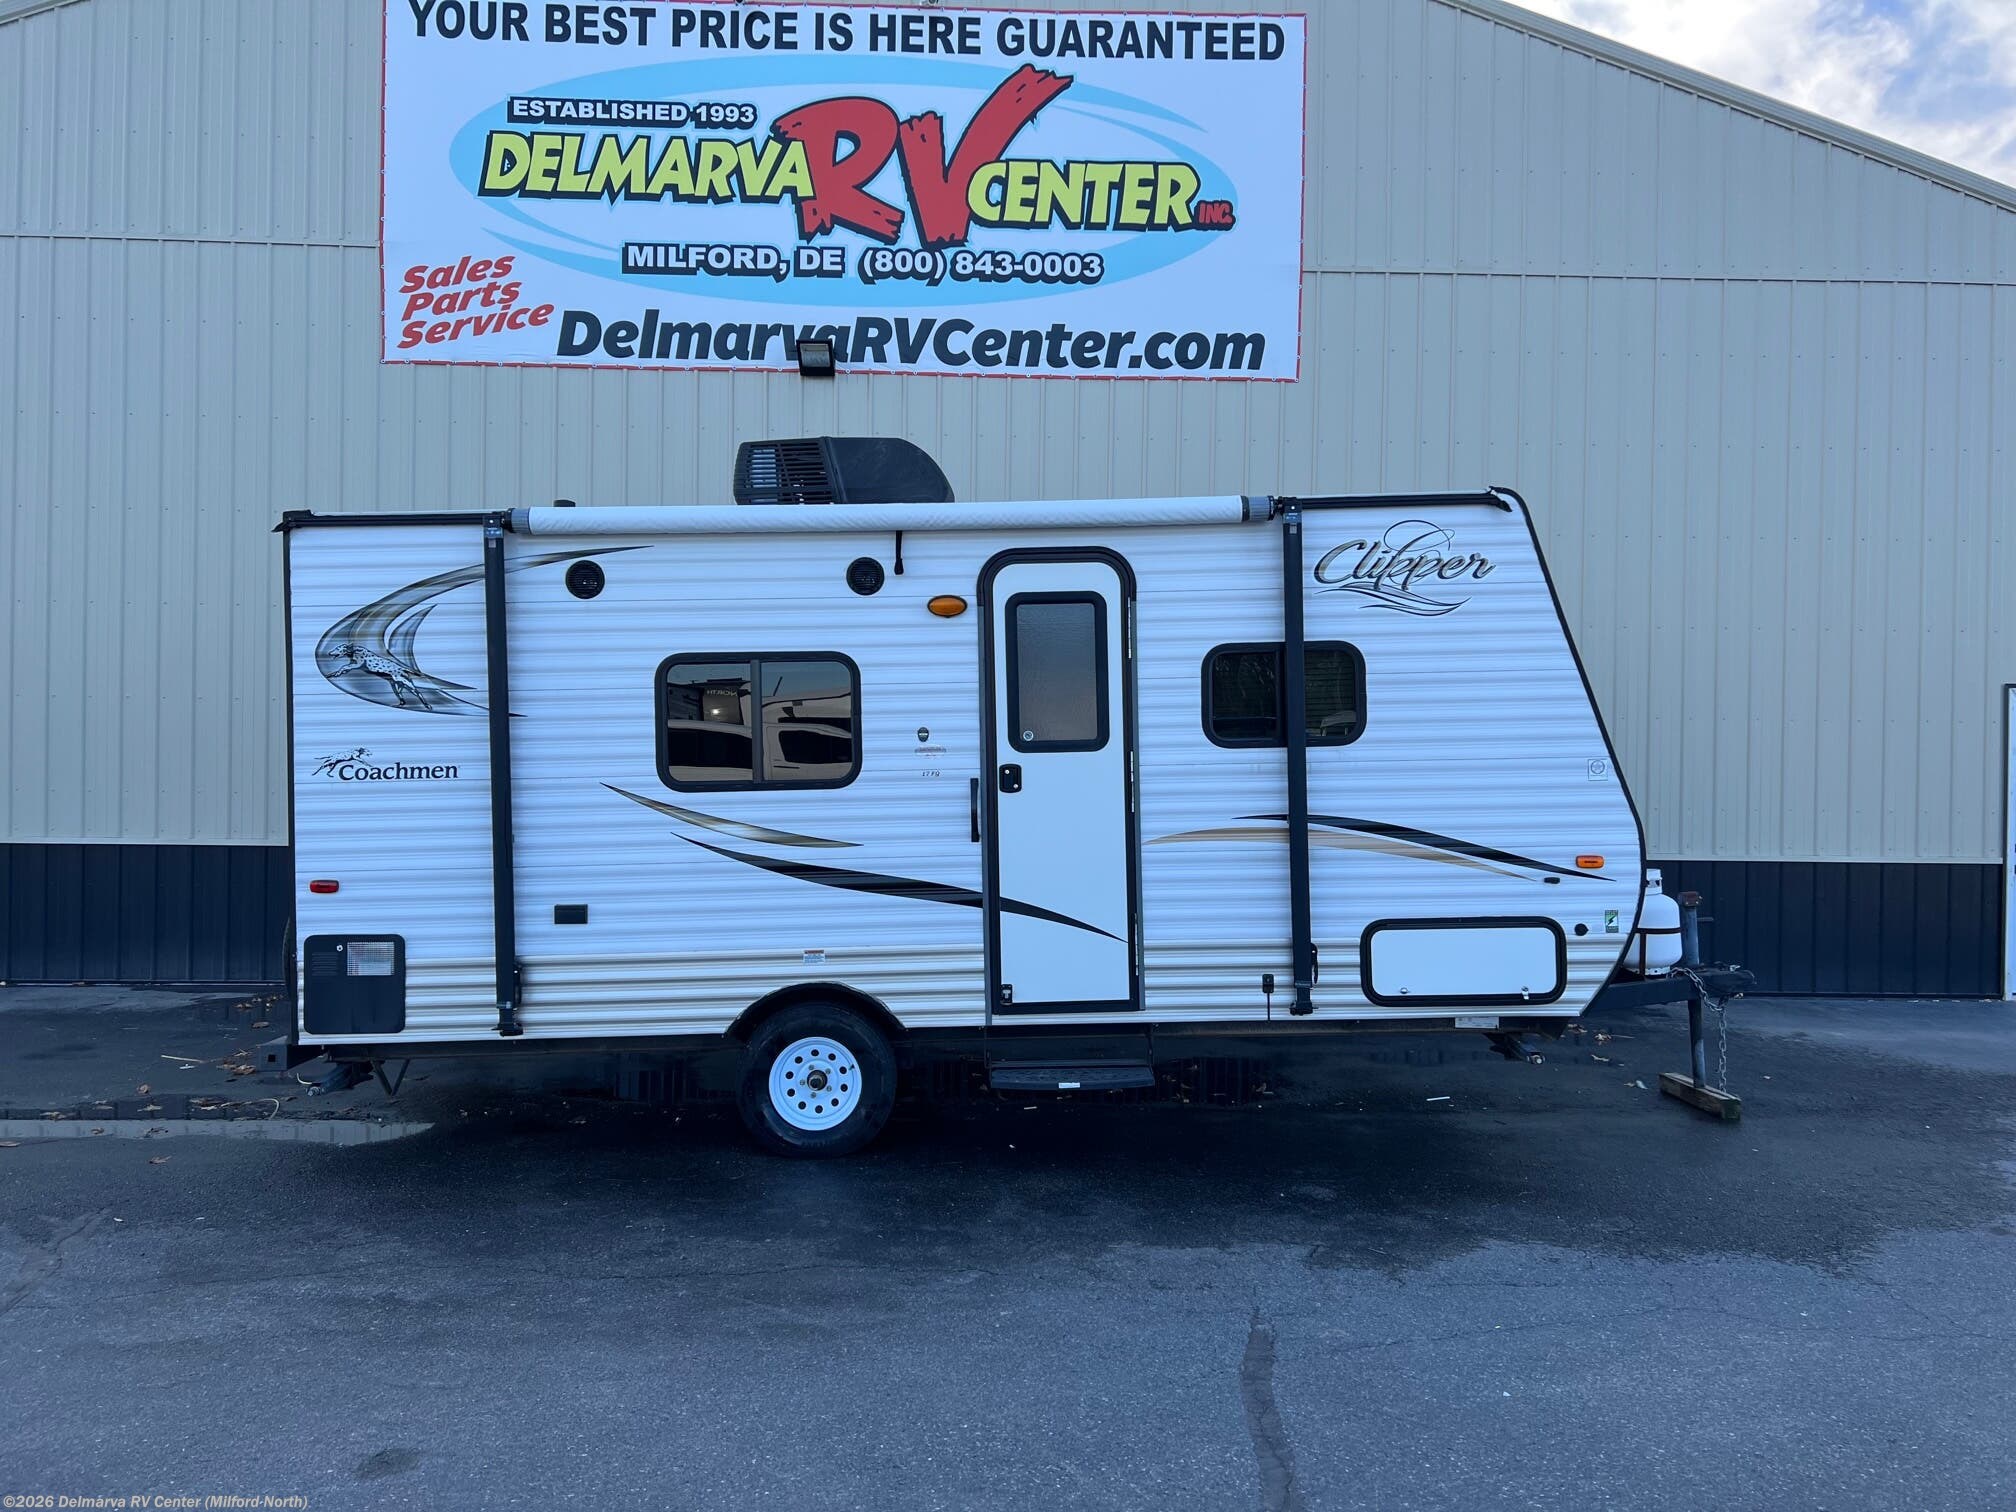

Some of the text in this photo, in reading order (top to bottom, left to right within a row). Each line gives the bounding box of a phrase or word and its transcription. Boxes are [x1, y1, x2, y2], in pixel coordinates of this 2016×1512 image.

[408, 0, 1286, 60] YOUR BEST PRICE IS HERE GUARANTEED
[512, 100, 756, 123] ESTABLISHED 1993
[484, 131, 815, 200] DELMARVA
[775, 63, 1074, 249] RV
[967, 161, 1200, 228] CENTER
[399, 255, 516, 293] Sales
[626, 245, 1102, 280] MILFORD, DE (800) 843-0003
[401, 281, 522, 321] Parts
[397, 303, 555, 349] Service
[1314, 519, 1497, 592] Clipper
[338, 761, 459, 781] Coachmen
